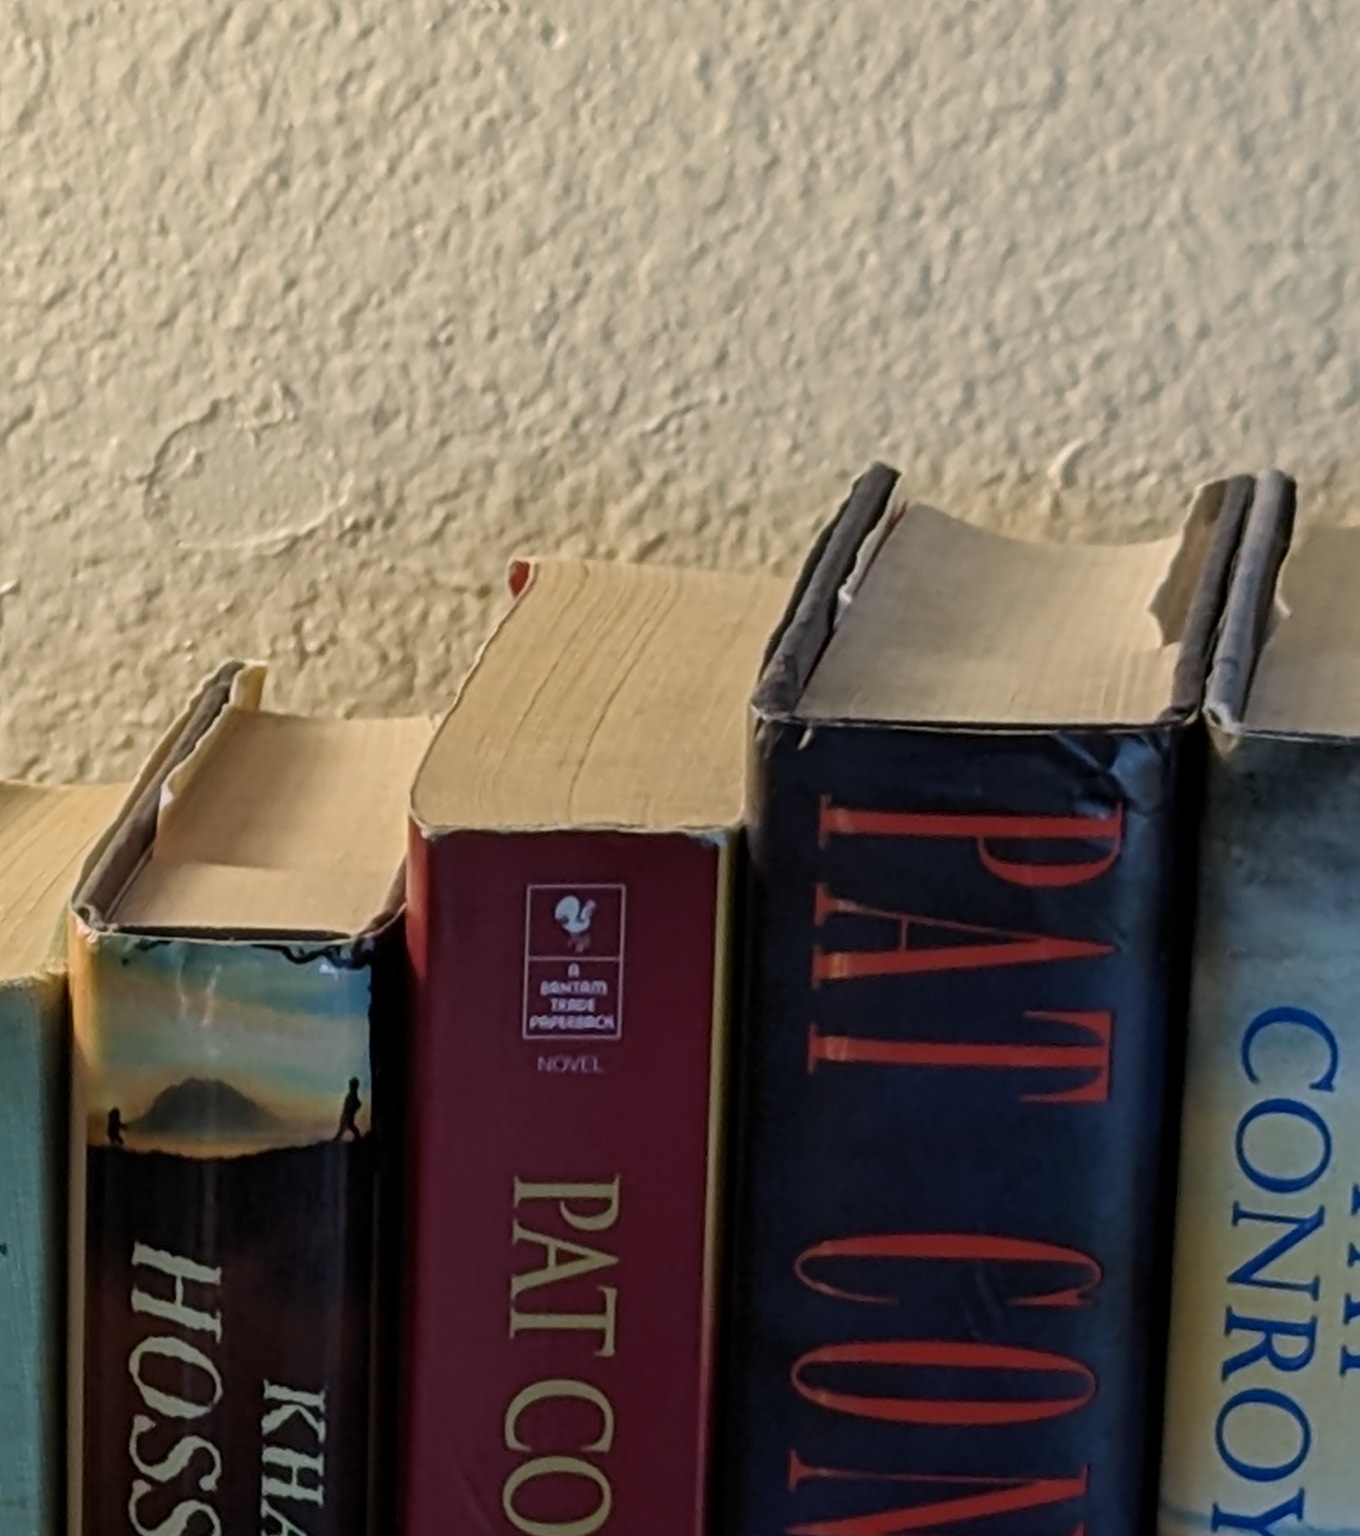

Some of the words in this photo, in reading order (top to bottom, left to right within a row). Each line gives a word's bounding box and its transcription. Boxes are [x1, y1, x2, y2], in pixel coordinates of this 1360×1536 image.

[807, 795, 1123, 1105] PAT
[537, 1056, 602, 1072] NOVEL
[508, 1173, 621, 1359] PAT
